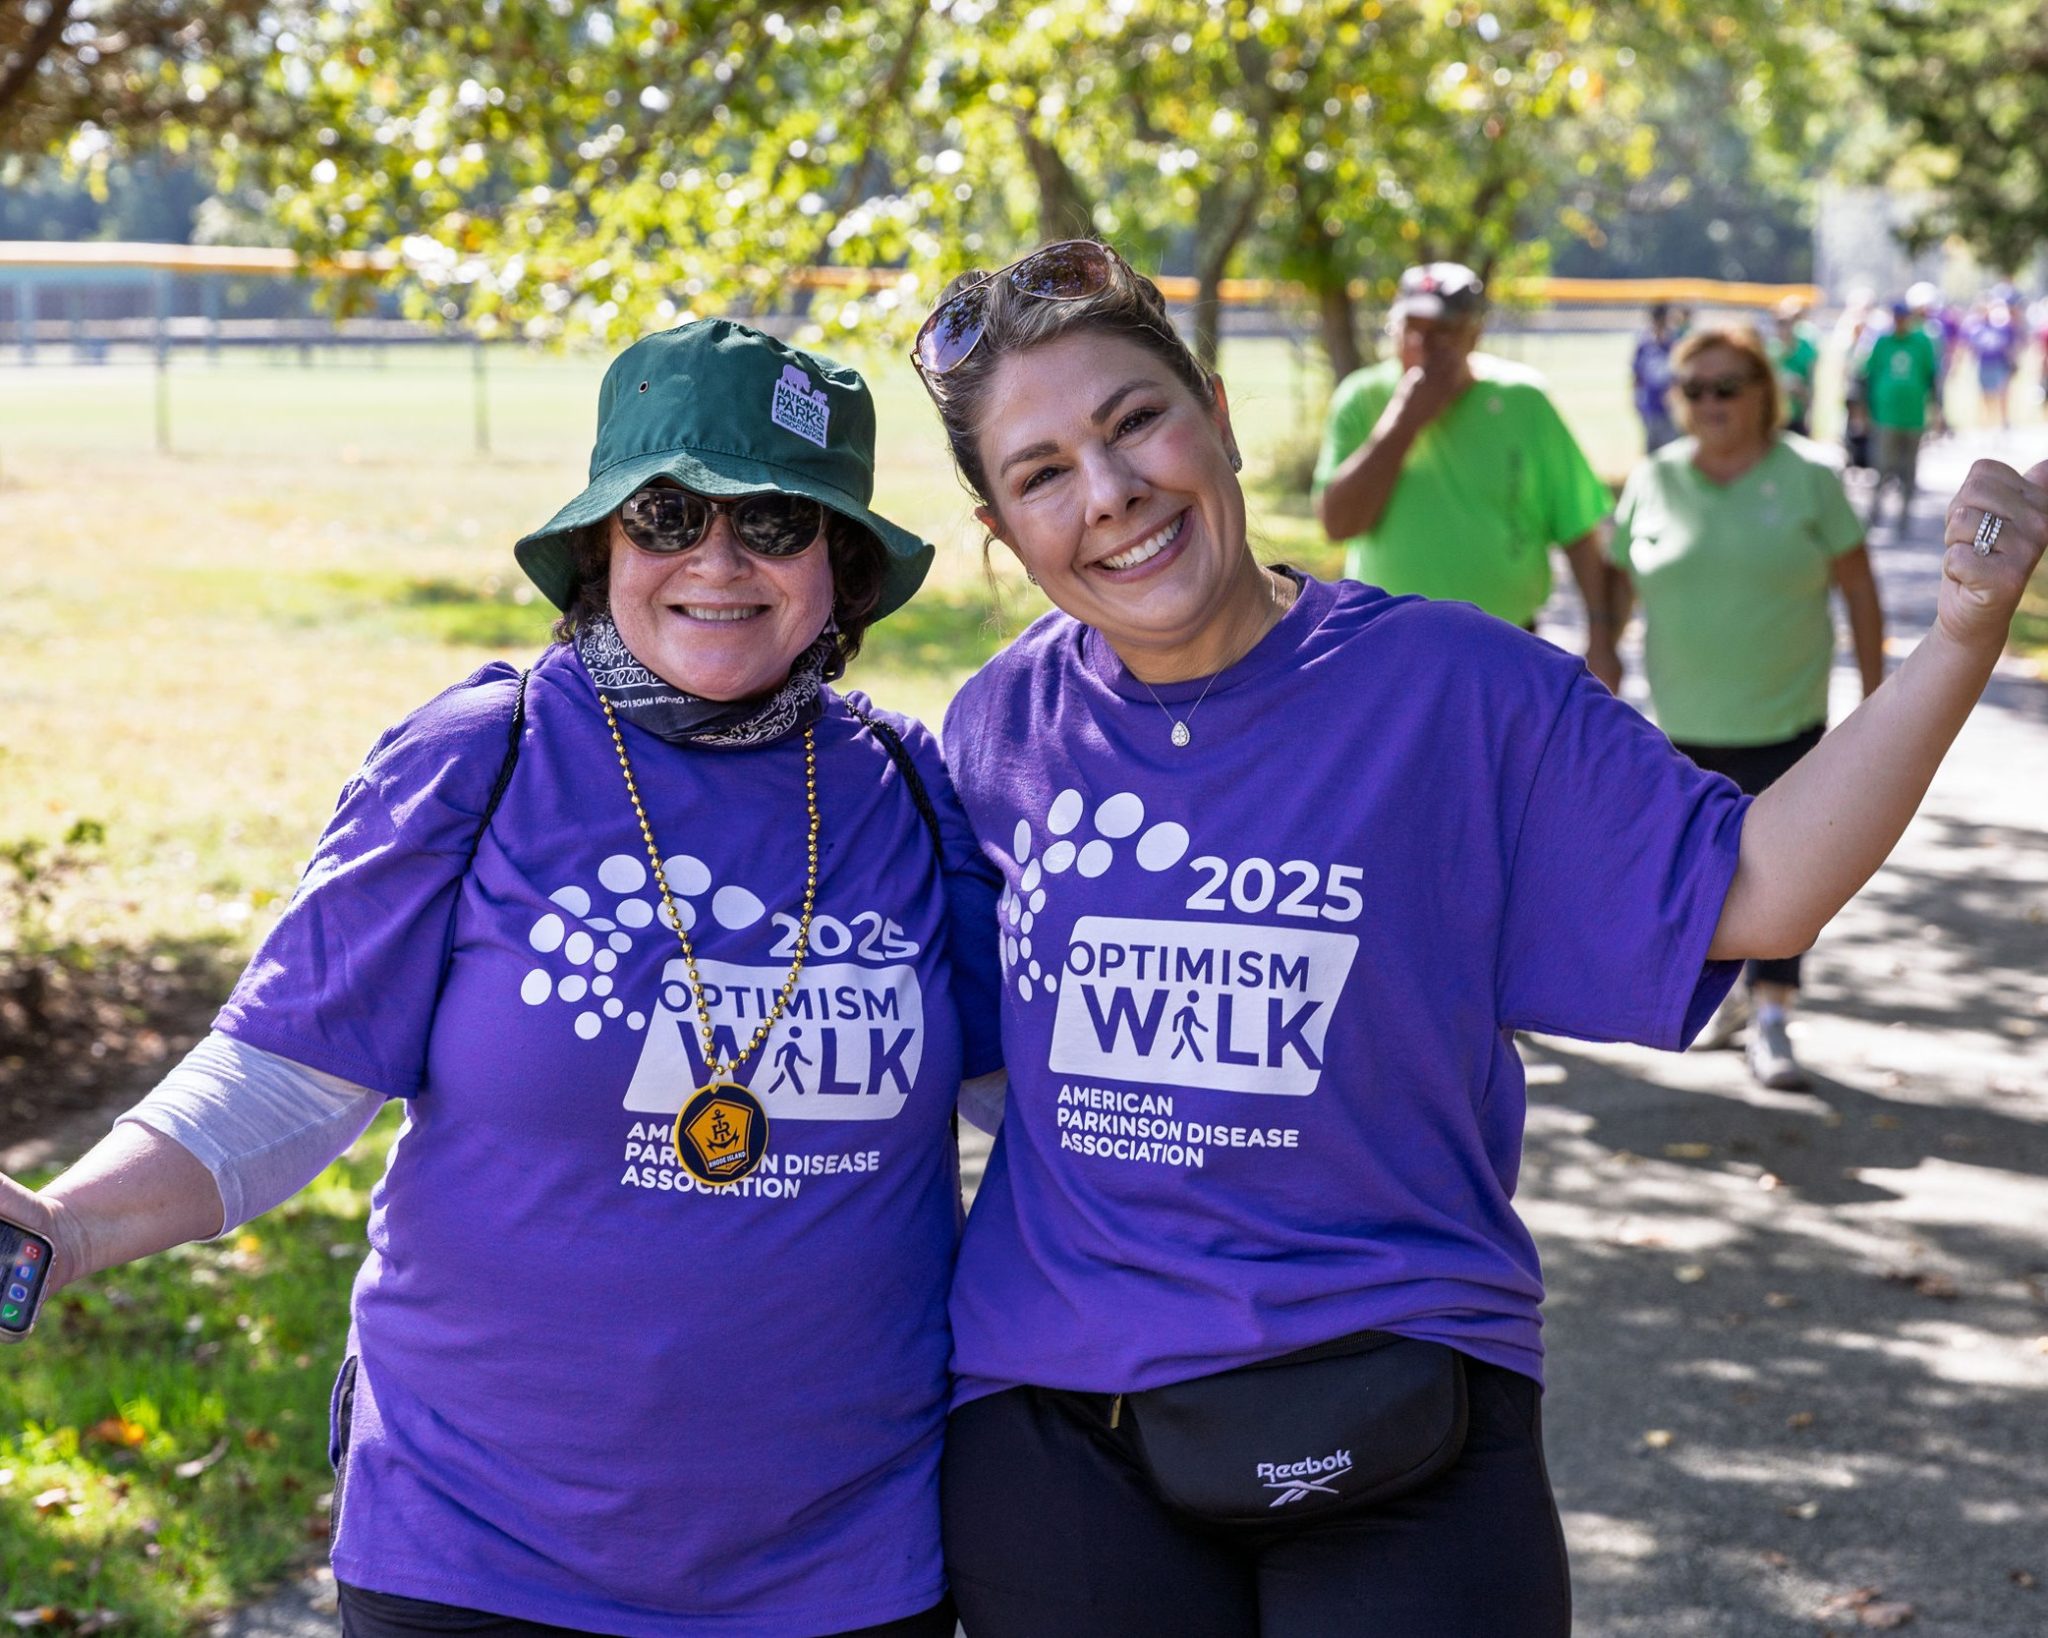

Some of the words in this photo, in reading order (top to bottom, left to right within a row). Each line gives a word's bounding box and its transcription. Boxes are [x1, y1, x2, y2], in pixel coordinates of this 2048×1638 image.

[776, 395, 825, 430] PARKS
[777, 385, 825, 417] NATIONAL
[1185, 855, 1364, 923] 2025
[768, 910, 920, 961] 2025
[1066, 940, 1310, 993] OPTIMISM
[657, 979, 900, 1021] OPTIMISM
[1081, 983, 1325, 1071] WLK
[676, 1019, 917, 1095] WLK
[1057, 1084, 1174, 1117] AMERICAN
[1057, 1107, 1183, 1141] PARKINSON
[1186, 1122, 1300, 1148] DISEASE
[708, 1156, 727, 1168] RHODE
[726, 1151, 746, 1163] ISLAND
[784, 1151, 880, 1177] DISEASE
[1060, 1131, 1204, 1168] ASSOCIATION
[1257, 1448, 1353, 1483] Reebok
